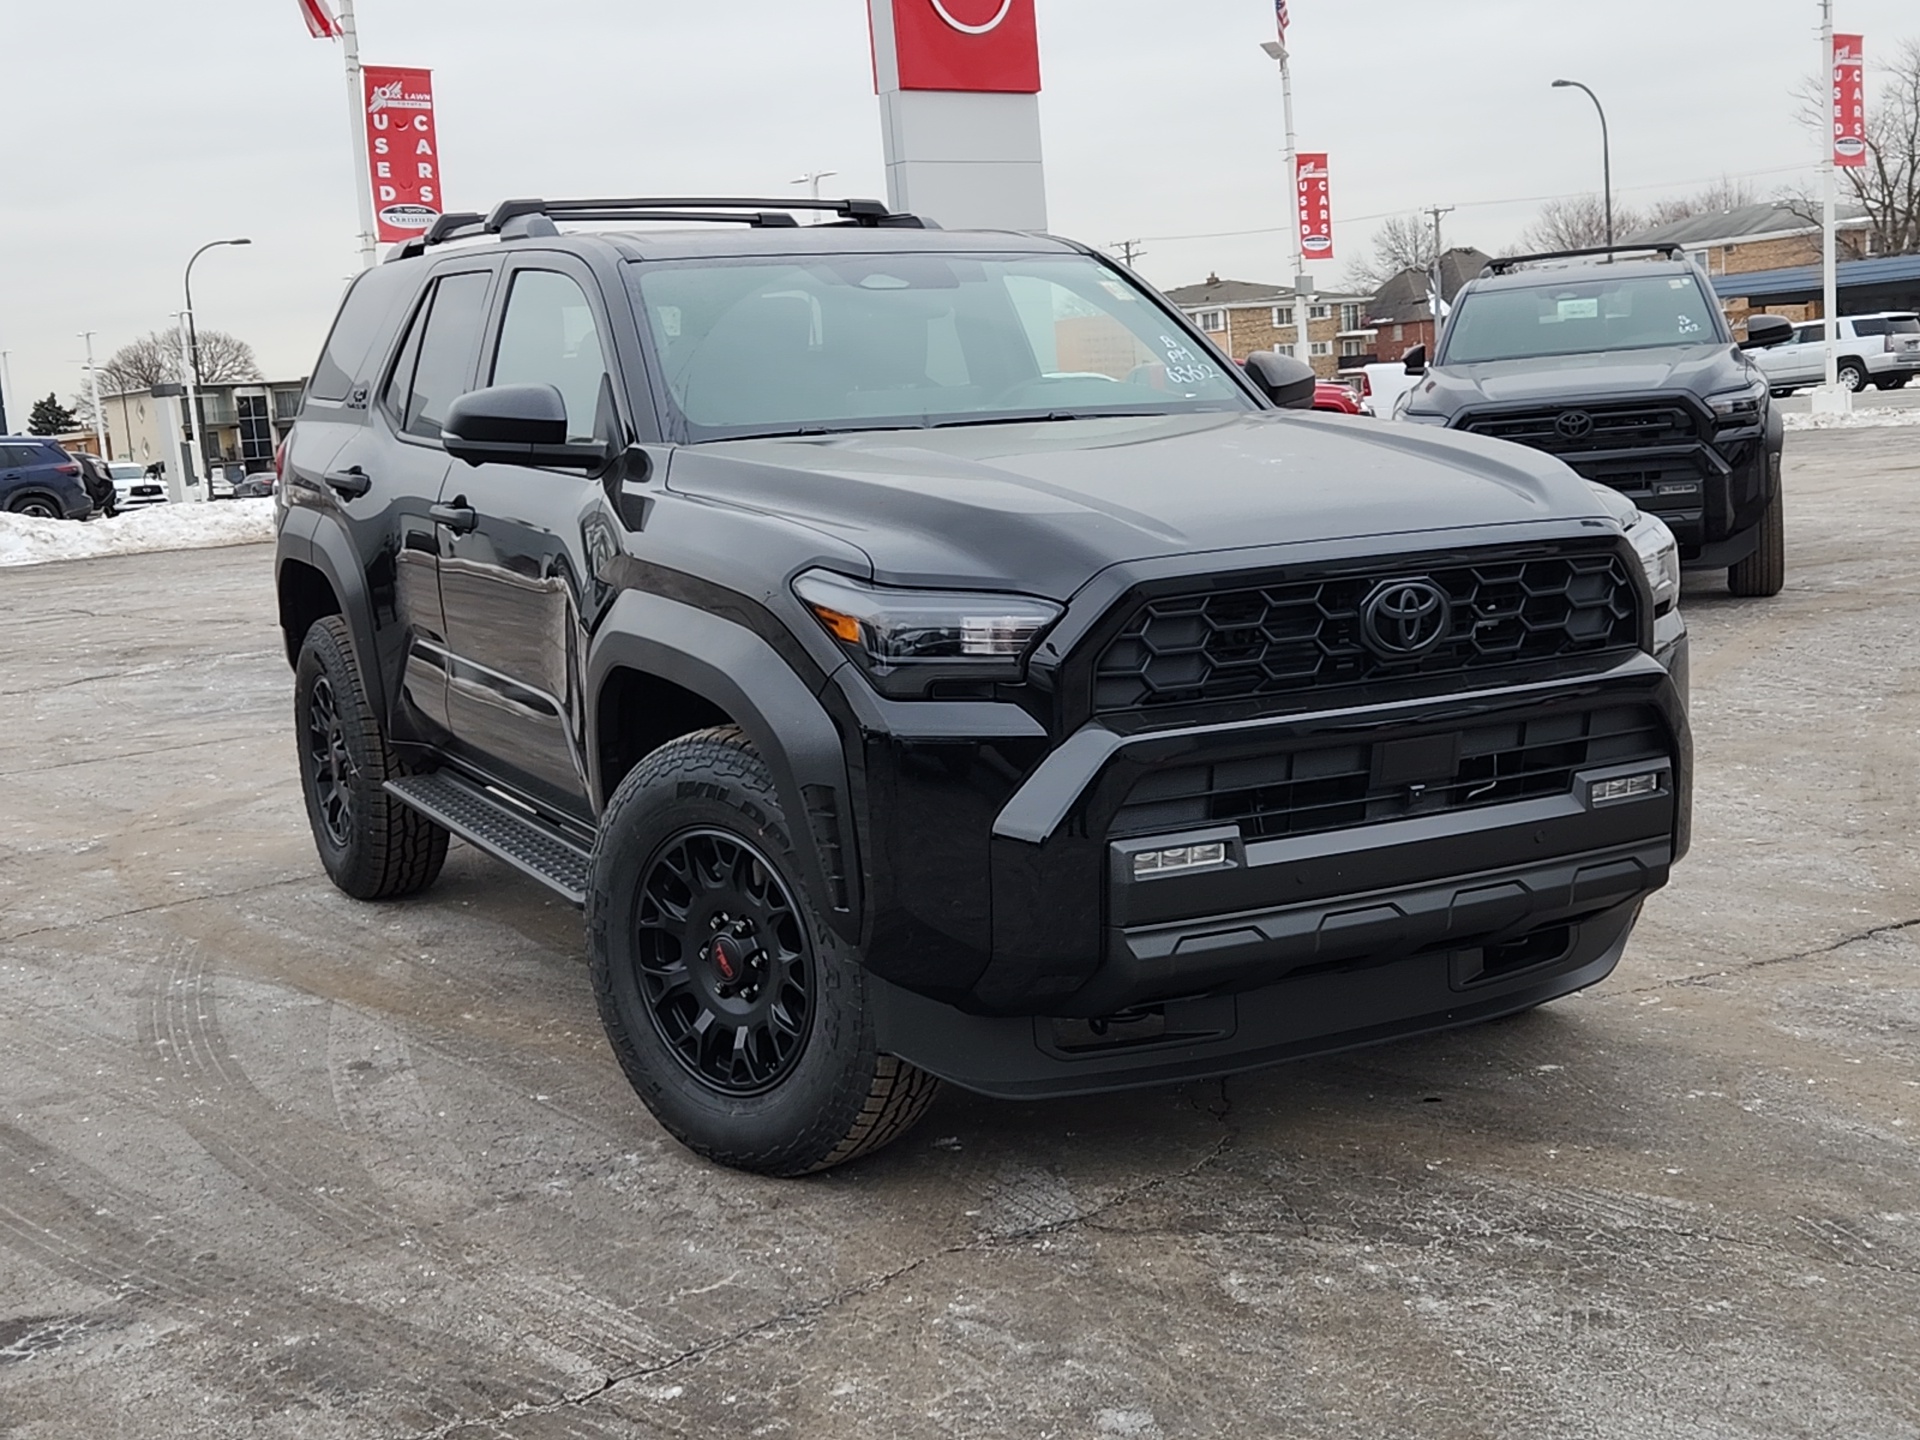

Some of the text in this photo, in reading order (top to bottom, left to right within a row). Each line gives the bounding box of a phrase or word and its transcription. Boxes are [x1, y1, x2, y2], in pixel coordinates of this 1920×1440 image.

[1833, 70, 1843, 135] USED
[1853, 69, 1862, 135] CARS
[373, 113, 396, 202] USED
[413, 115, 434, 202] CARS
[1299, 181, 1311, 234] USED
[1318, 181, 1329, 234] CARS
[1166, 364, 1220, 383] 6362
[716, 942, 734, 978] TRD
